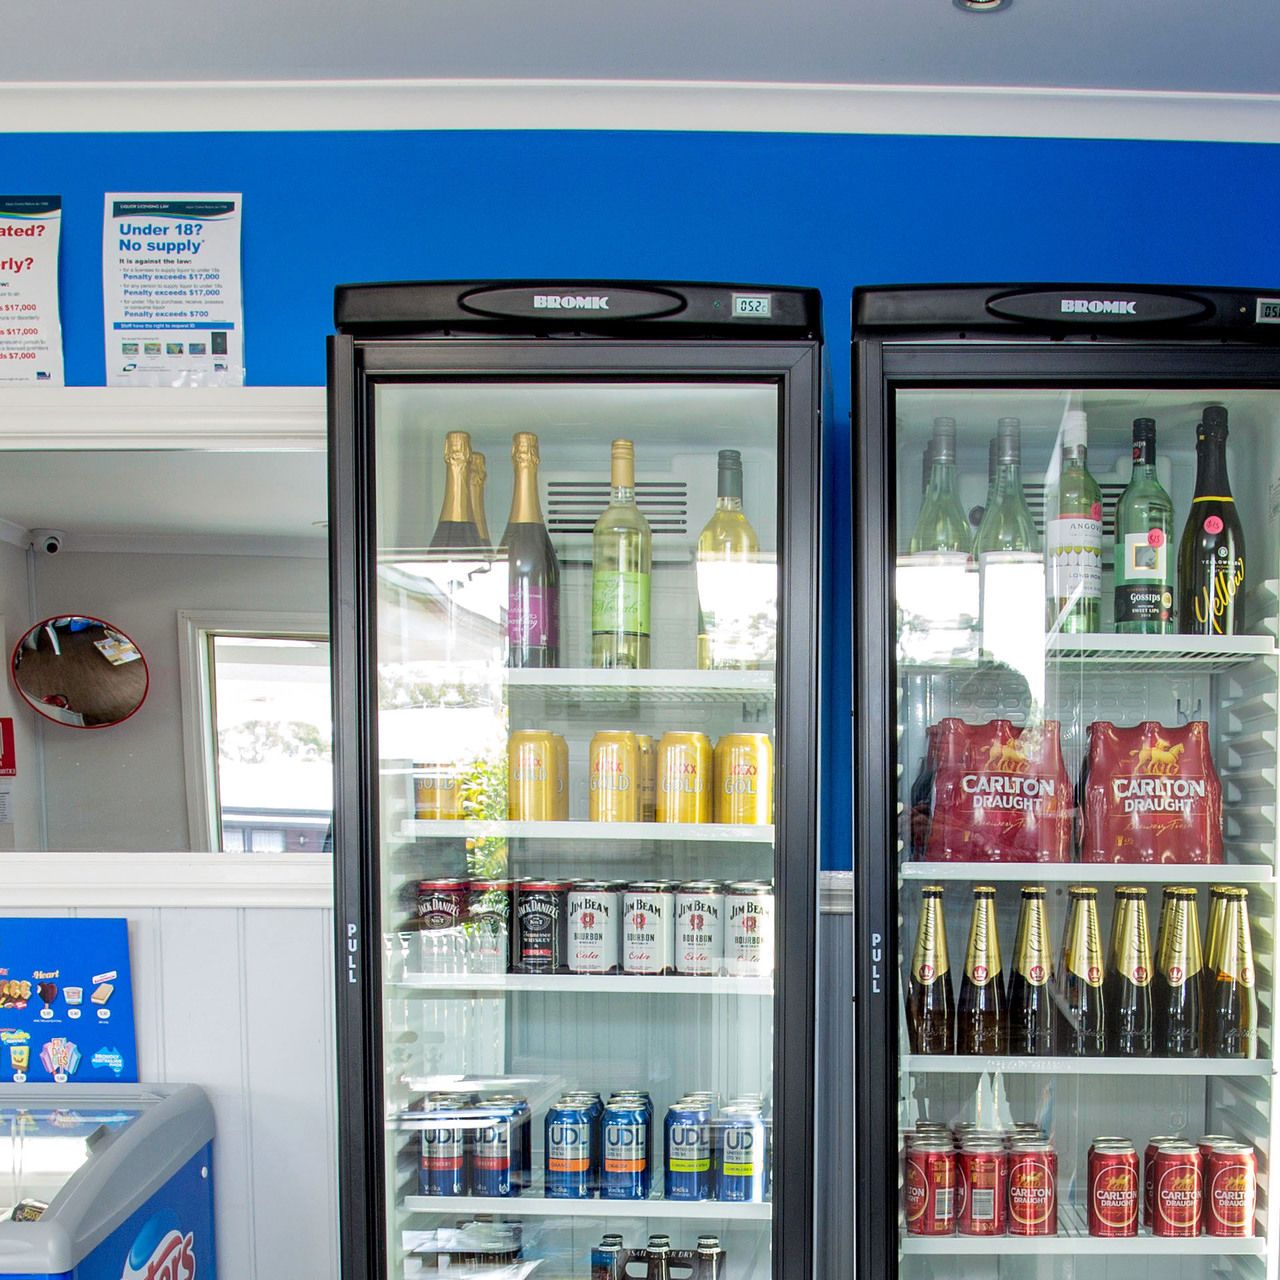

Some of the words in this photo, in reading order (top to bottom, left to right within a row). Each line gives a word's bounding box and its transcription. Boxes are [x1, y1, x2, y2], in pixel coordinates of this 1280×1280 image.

[120, 224, 169, 236] Under
[175, 223, 203, 236] 18?
[119, 239, 141, 251] No
[5, 304, 37, 312] $17,000
[534, 295, 609, 310] BROMIC
[1061, 300, 1136, 314] BROMIC
[7, 328, 39, 336] $17,000
[9, 352, 36, 360] $7,000
[590, 776, 630, 792] GOLD
[961, 774, 1055, 797] CARLTON
[1113, 778, 1206, 798] CARLTON
[973, 796, 1042, 812] DRAUGHT
[1124, 797, 1193, 813] DRAUGHT
[570, 899, 586, 915] JIM
[587, 899, 610, 918] BEAM
[574, 933, 603, 941] BOURBON
[348, 924, 357, 983] PULL
[872, 933, 881, 993] PULL
[606, 1125, 644, 1147] UDL
[671, 1126, 708, 1146] UDL
